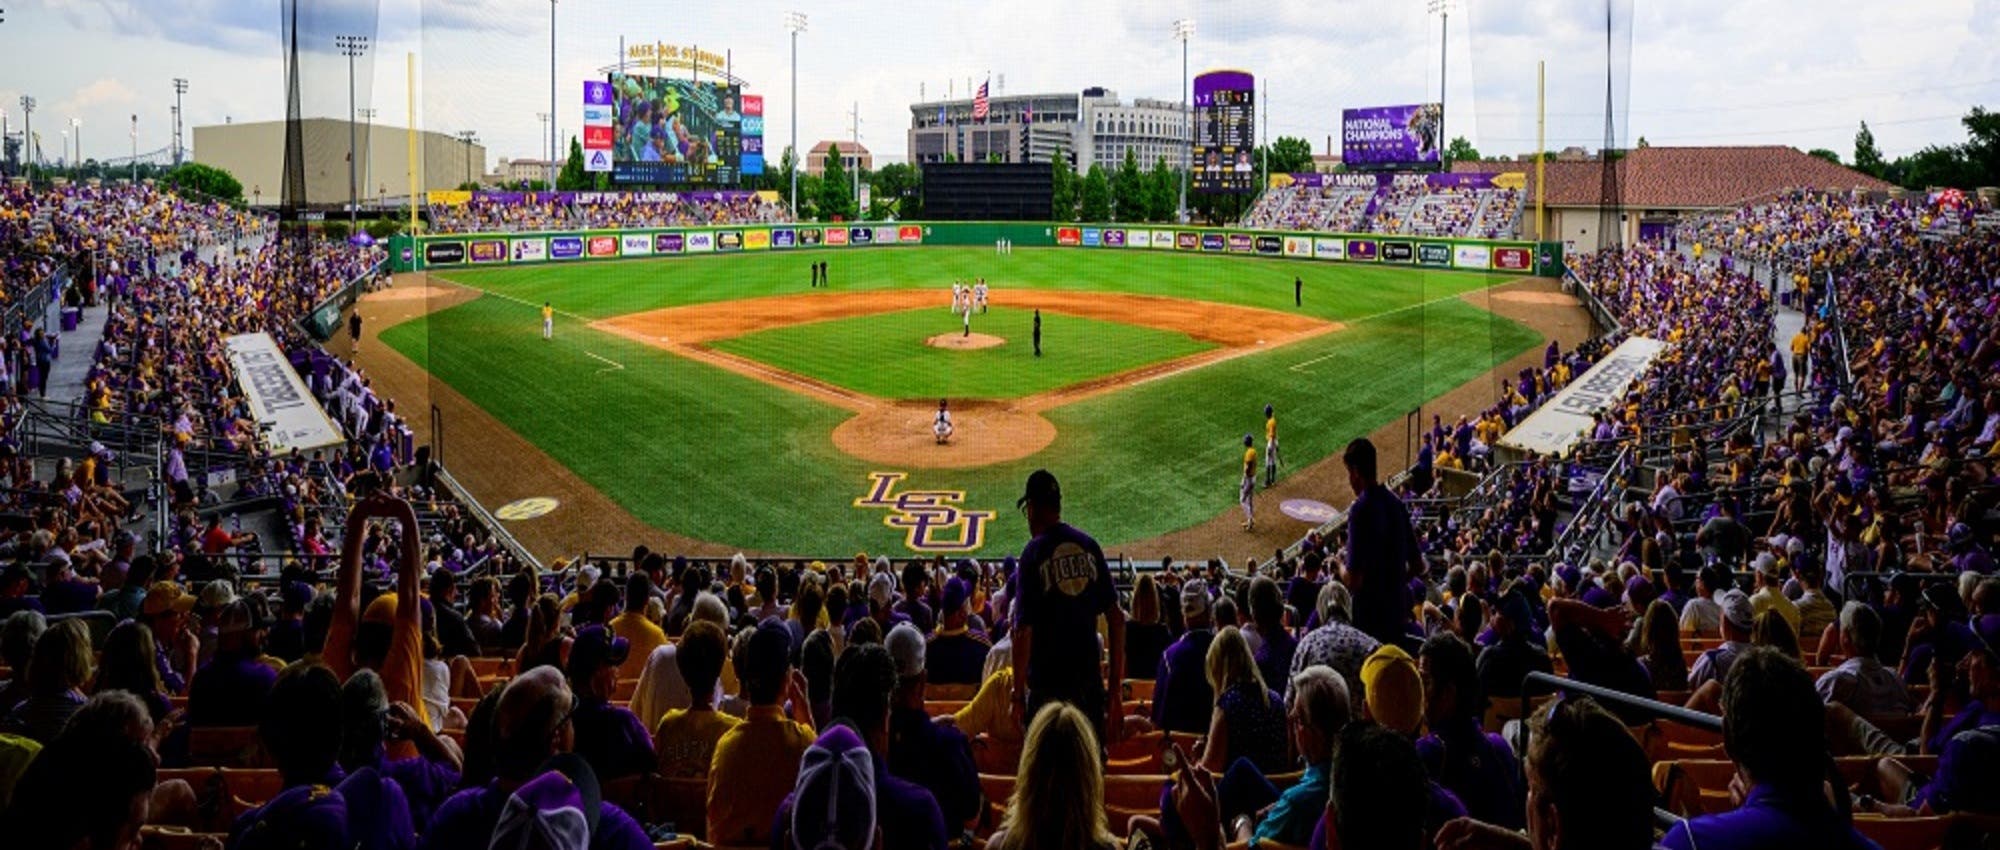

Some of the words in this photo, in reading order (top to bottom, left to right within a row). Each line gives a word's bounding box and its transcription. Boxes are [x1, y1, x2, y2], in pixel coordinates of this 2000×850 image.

[1345, 118, 1391, 130] NATIONAL
[1345, 129, 1403, 142] CHAMPIONS
[1321, 174, 1377, 186] DIAMOND
[1393, 174, 1429, 186] DECK
[575, 192, 602, 204] LEFT
[634, 192, 678, 203] LANDING
[853, 472, 997, 552] LSU
[1039, 551, 1099, 593] TIGERS
